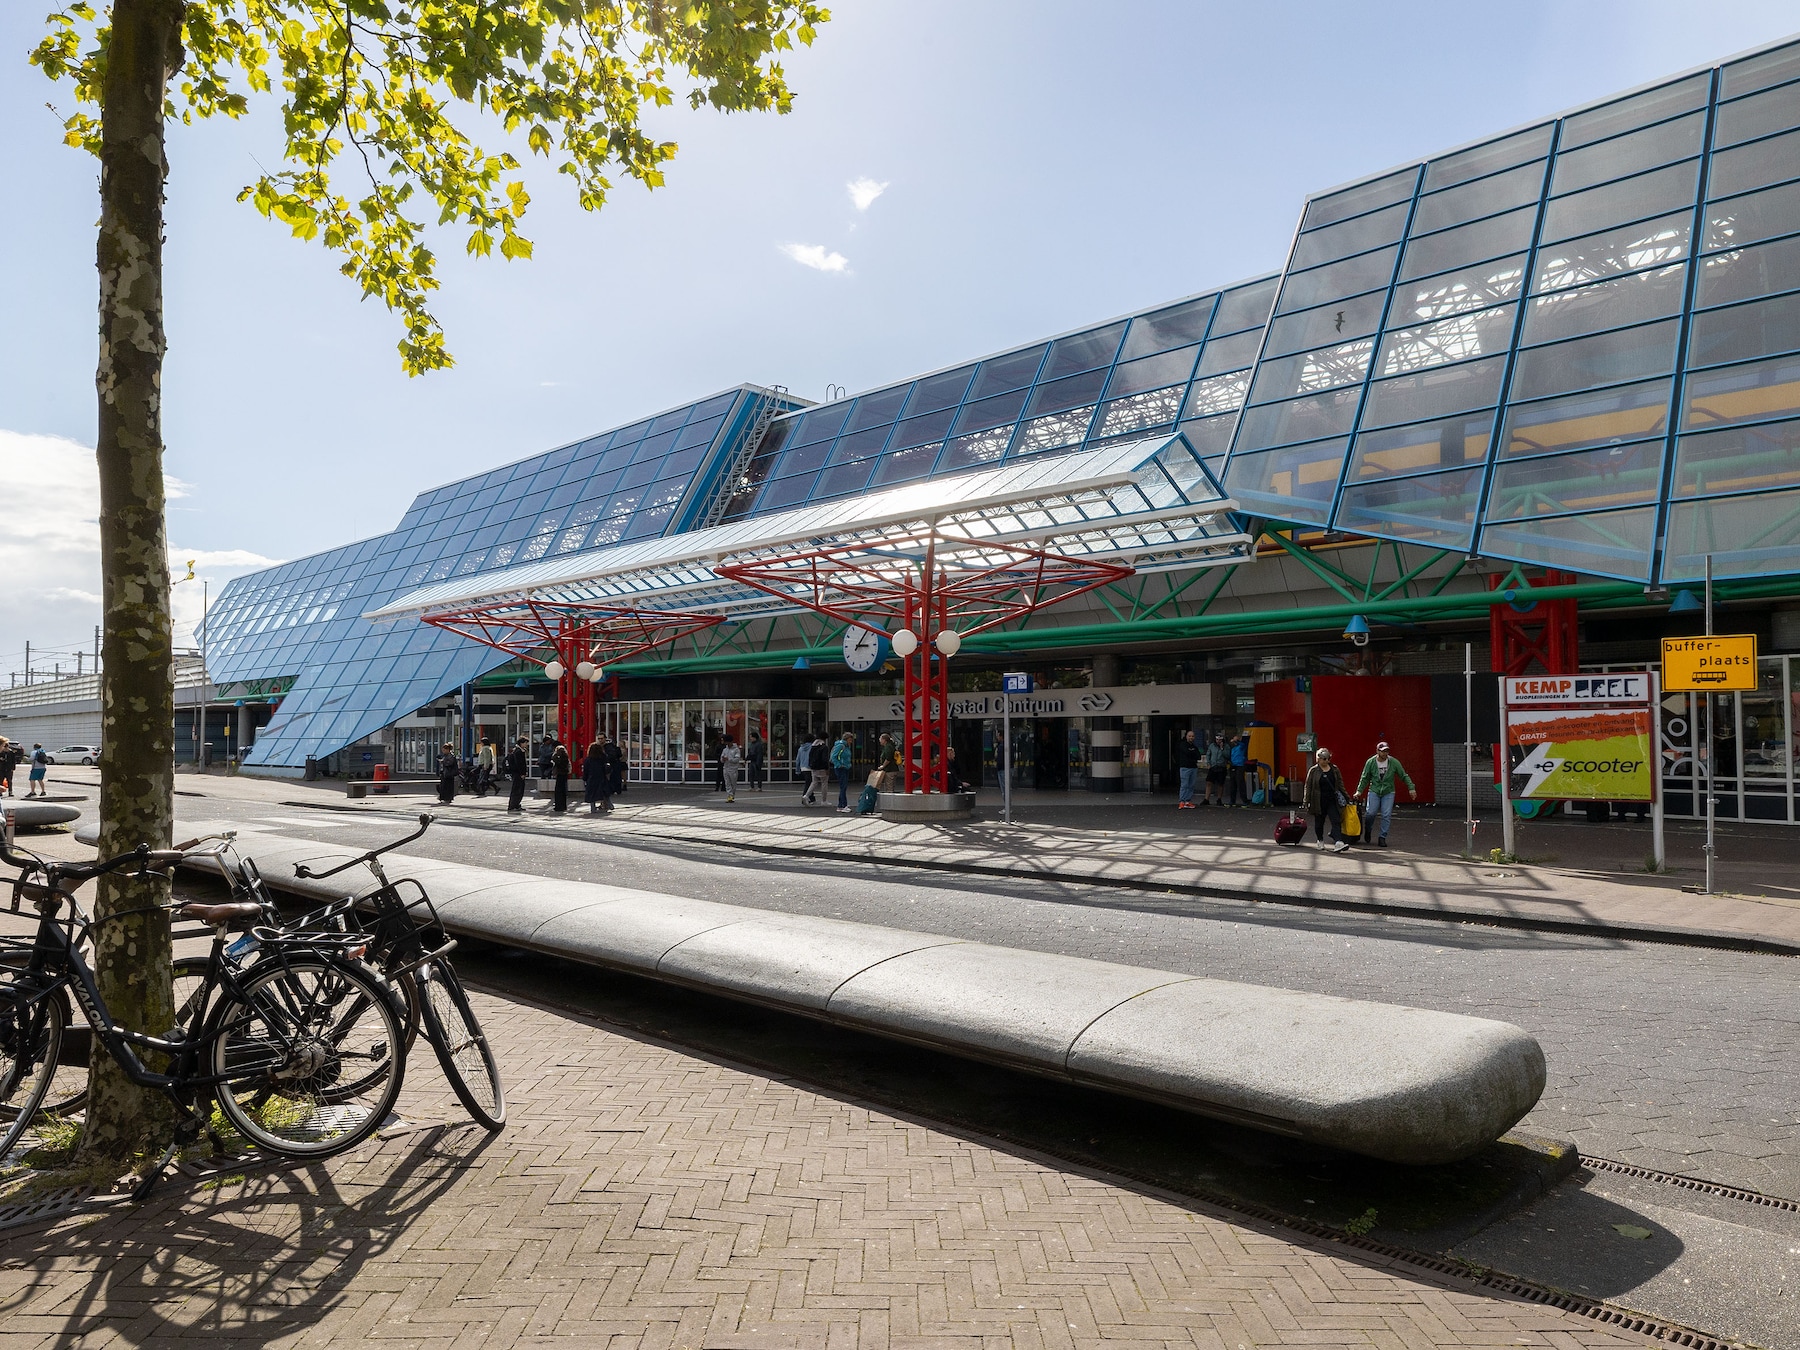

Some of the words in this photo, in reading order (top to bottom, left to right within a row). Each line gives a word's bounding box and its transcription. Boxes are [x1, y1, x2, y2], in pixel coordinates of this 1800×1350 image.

[1609, 438, 1623, 456] 2
[1665, 641, 1721, 652] buffer-
[1700, 655, 1749, 667] plaats
[1515, 680, 1572, 694] KEMP
[1519, 732, 1547, 740] GRATIS
[1562, 758, 1643, 773] scooter
[69, 973, 108, 1032] AVALON
